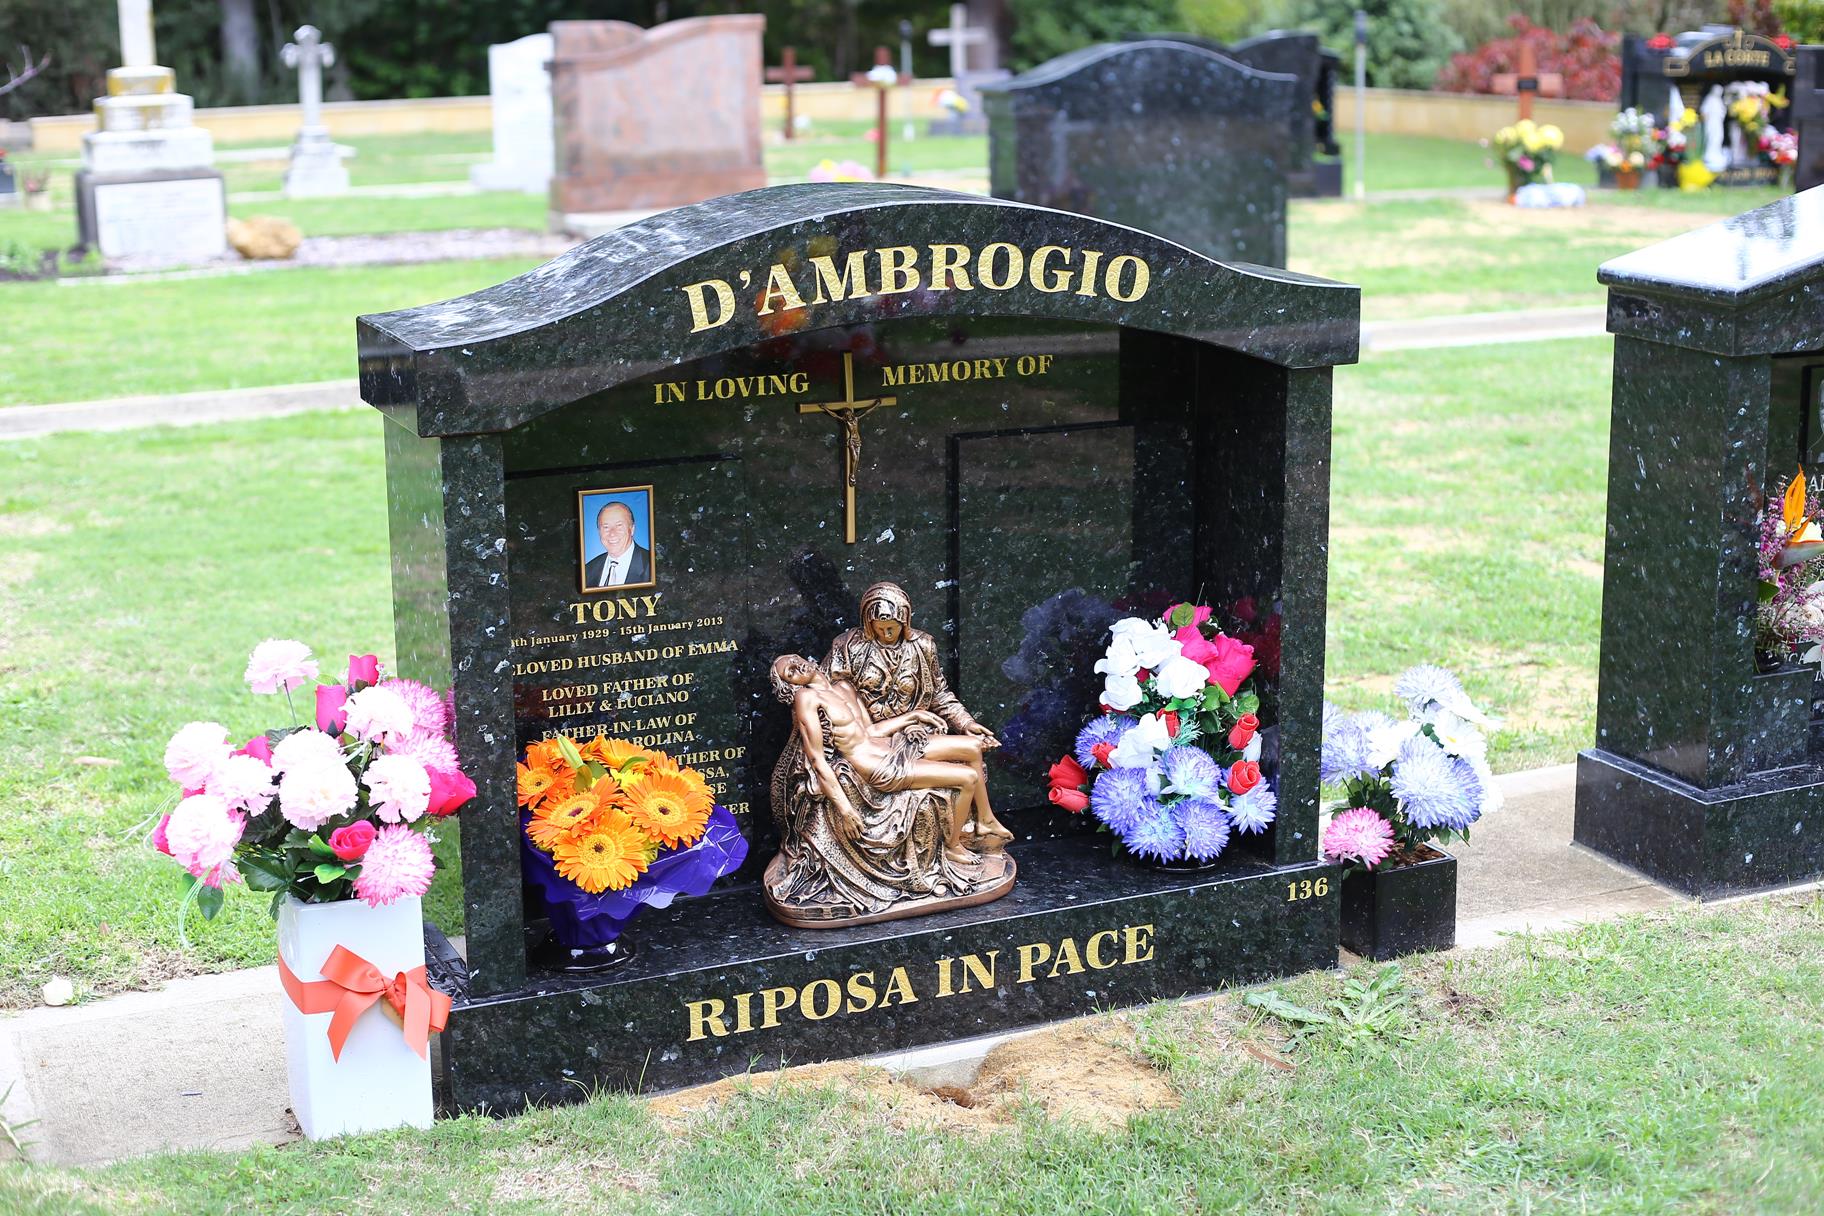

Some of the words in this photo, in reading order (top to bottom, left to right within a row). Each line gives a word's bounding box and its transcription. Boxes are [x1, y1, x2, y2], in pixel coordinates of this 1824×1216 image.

[1704, 50, 1724, 68] LA
[682, 242, 1150, 334] D'AMBROGIO
[654, 381, 688, 405] IN
[696, 372, 810, 401] LOVING
[881, 357, 1008, 387] MEMORY
[1017, 354, 1053, 376] OF
[569, 593, 663, 625] TONY
[531, 633, 578, 648] January
[582, 628, 610, 640] 1929
[620, 625, 645, 636] 15th
[648, 620, 694, 635] January
[697, 616, 723, 628] 2013
[577, 648, 658, 669] HUSBAND
[662, 645, 684, 659] OF
[688, 639, 739, 656] EMMA
[542, 684, 598, 702] LOVED
[603, 675, 669, 694] FATHER
[672, 673, 695, 686] OF
[548, 701, 596, 718] LILLY
[599, 699, 612, 712] &
[616, 690, 689, 710] LUCIANO
[542, 716, 671, 741] FATHER-IN-LAW
[675, 712, 697, 726] OF
[725, 746, 746, 759] OF
[1287, 877, 1328, 902] 136
[685, 966, 918, 1042] RIPOSA
[935, 950, 1000, 998] IN
[1016, 924, 1155, 984] PACE
